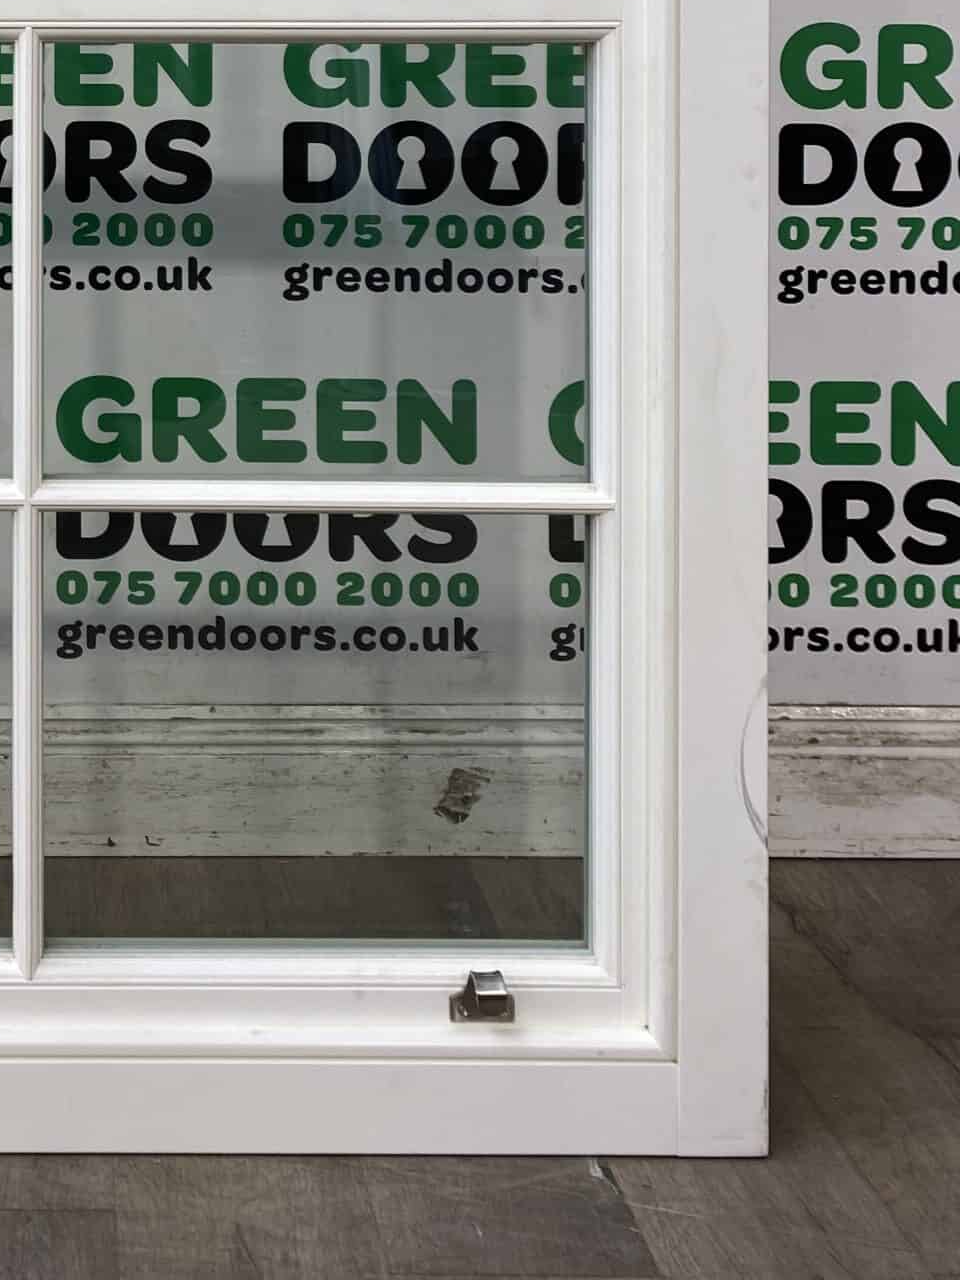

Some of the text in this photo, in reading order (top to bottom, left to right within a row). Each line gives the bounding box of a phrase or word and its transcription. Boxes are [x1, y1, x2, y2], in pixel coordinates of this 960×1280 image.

[72, 213, 214, 247] 2000
[283, 214, 383, 248] 075
[402, 214, 545, 248] 7000
[778, 216, 878, 250] 075
[283, 259, 584, 301] greendoors.
[777, 261, 960, 304] greend
[56, 375, 477, 465] GREEN
[56, 512, 478, 563] DOORS
[56, 571, 479, 607] 075 7000 2000
[57, 616, 478, 659] greendoors.co.uk
